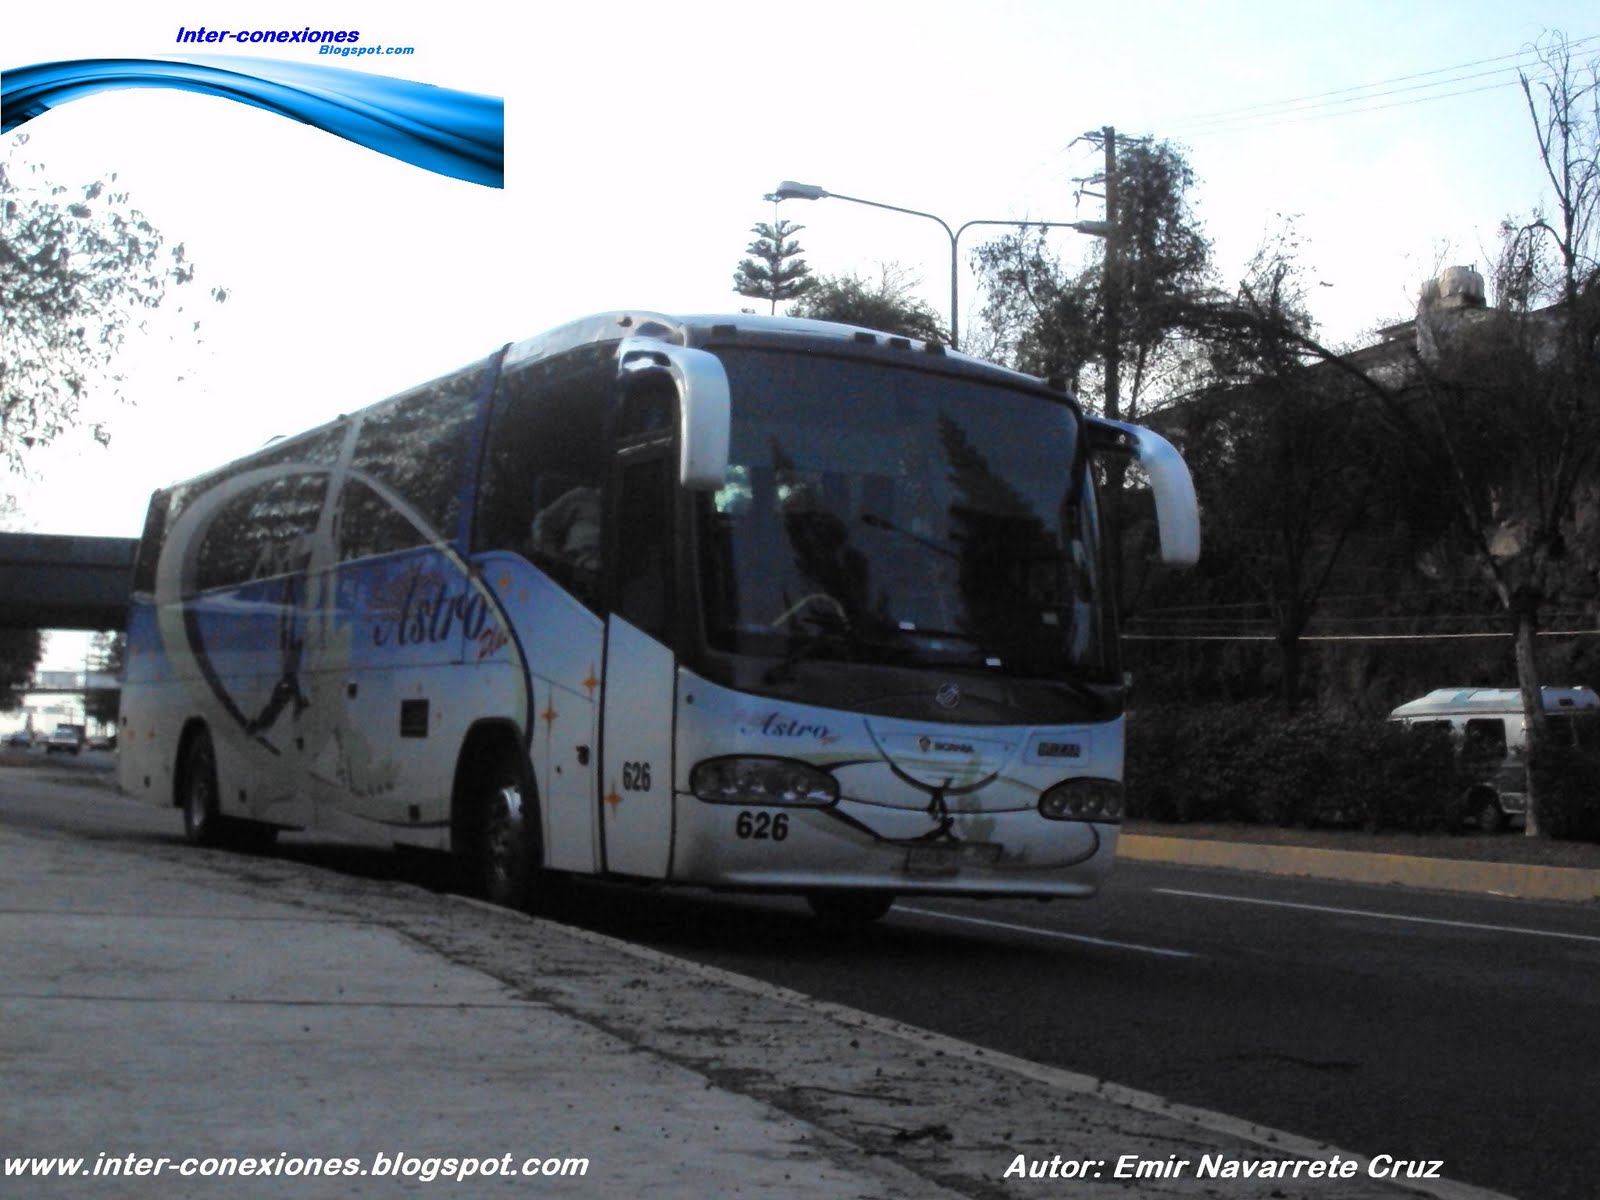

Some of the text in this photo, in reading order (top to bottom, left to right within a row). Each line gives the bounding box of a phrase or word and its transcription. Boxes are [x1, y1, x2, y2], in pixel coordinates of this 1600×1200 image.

[739, 711, 830, 739] Astro
[622, 761, 651, 792] 626
[735, 810, 789, 841] 626
